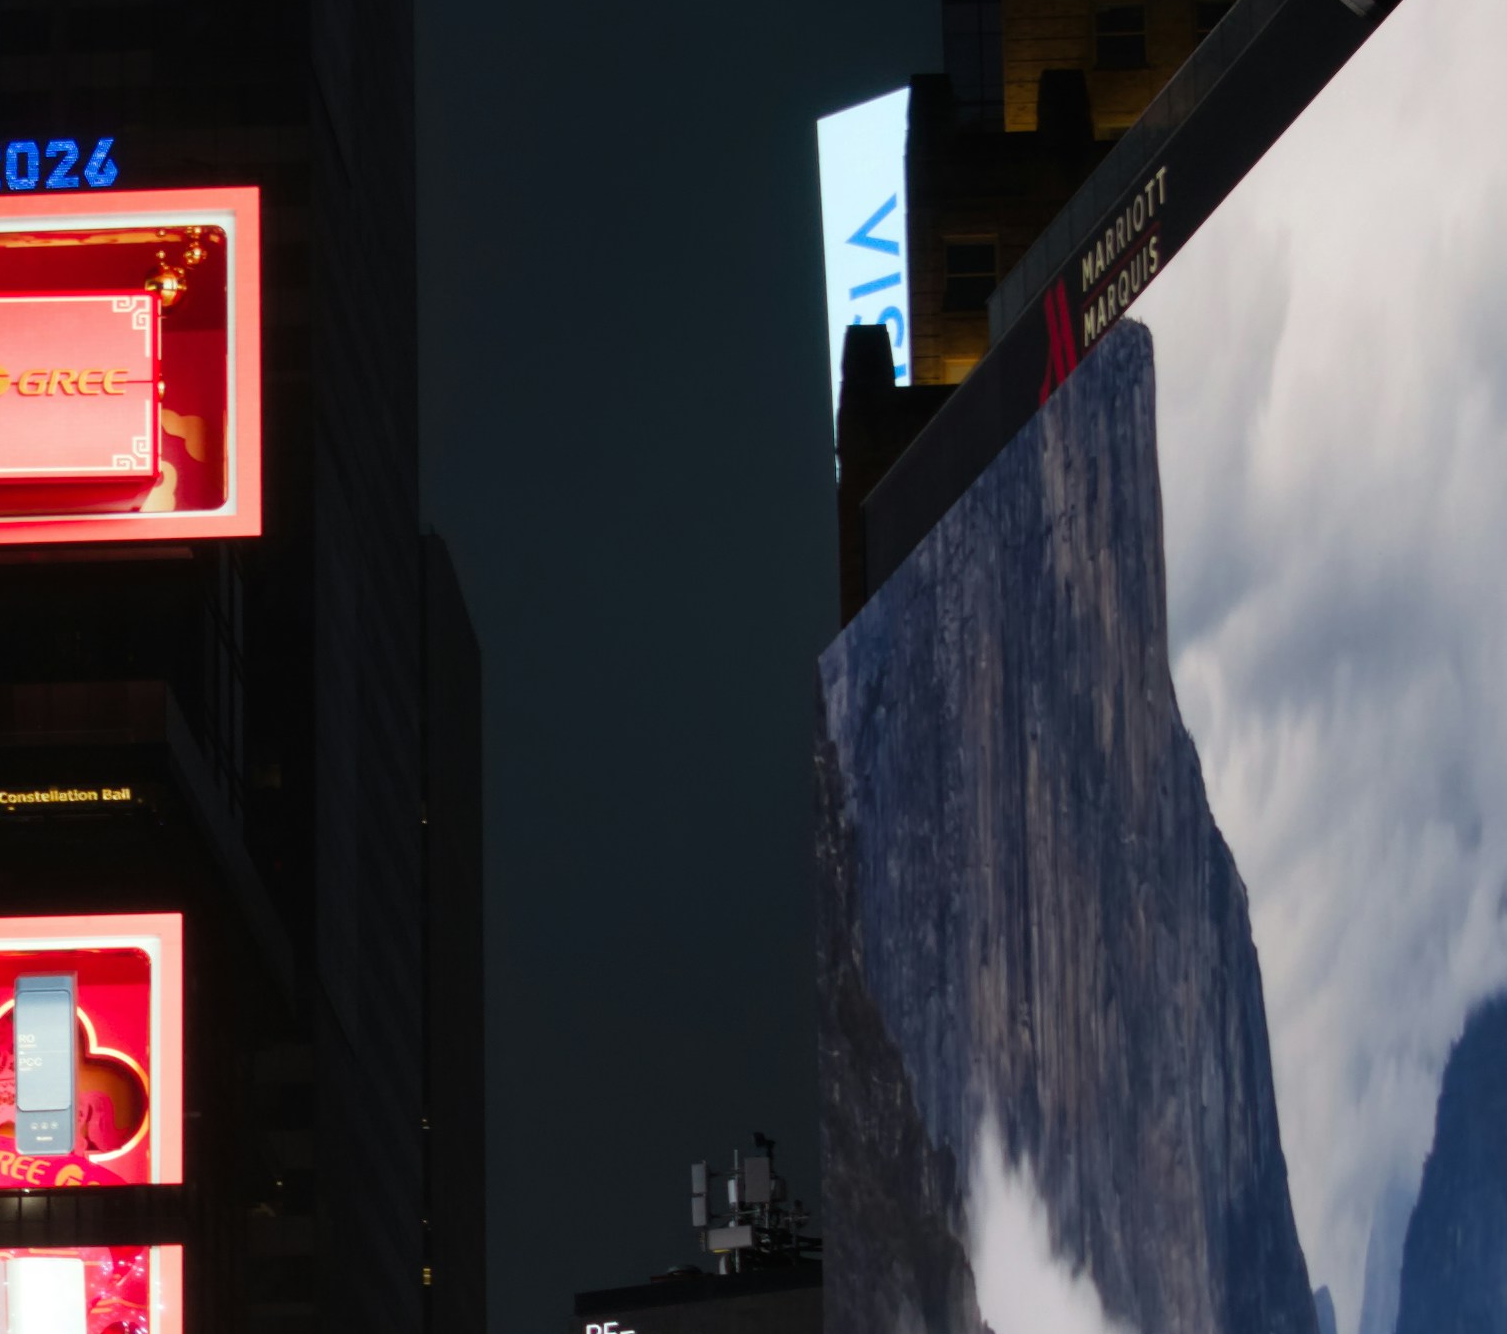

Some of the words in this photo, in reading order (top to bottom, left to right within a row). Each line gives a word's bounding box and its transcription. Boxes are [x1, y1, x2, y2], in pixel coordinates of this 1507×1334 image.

[1081, 166, 1168, 292] MARRIOTT
[1082, 236, 1161, 348] MARQUIS
[18, 368, 130, 397] GREE
[101, 787, 131, 803] Ball
